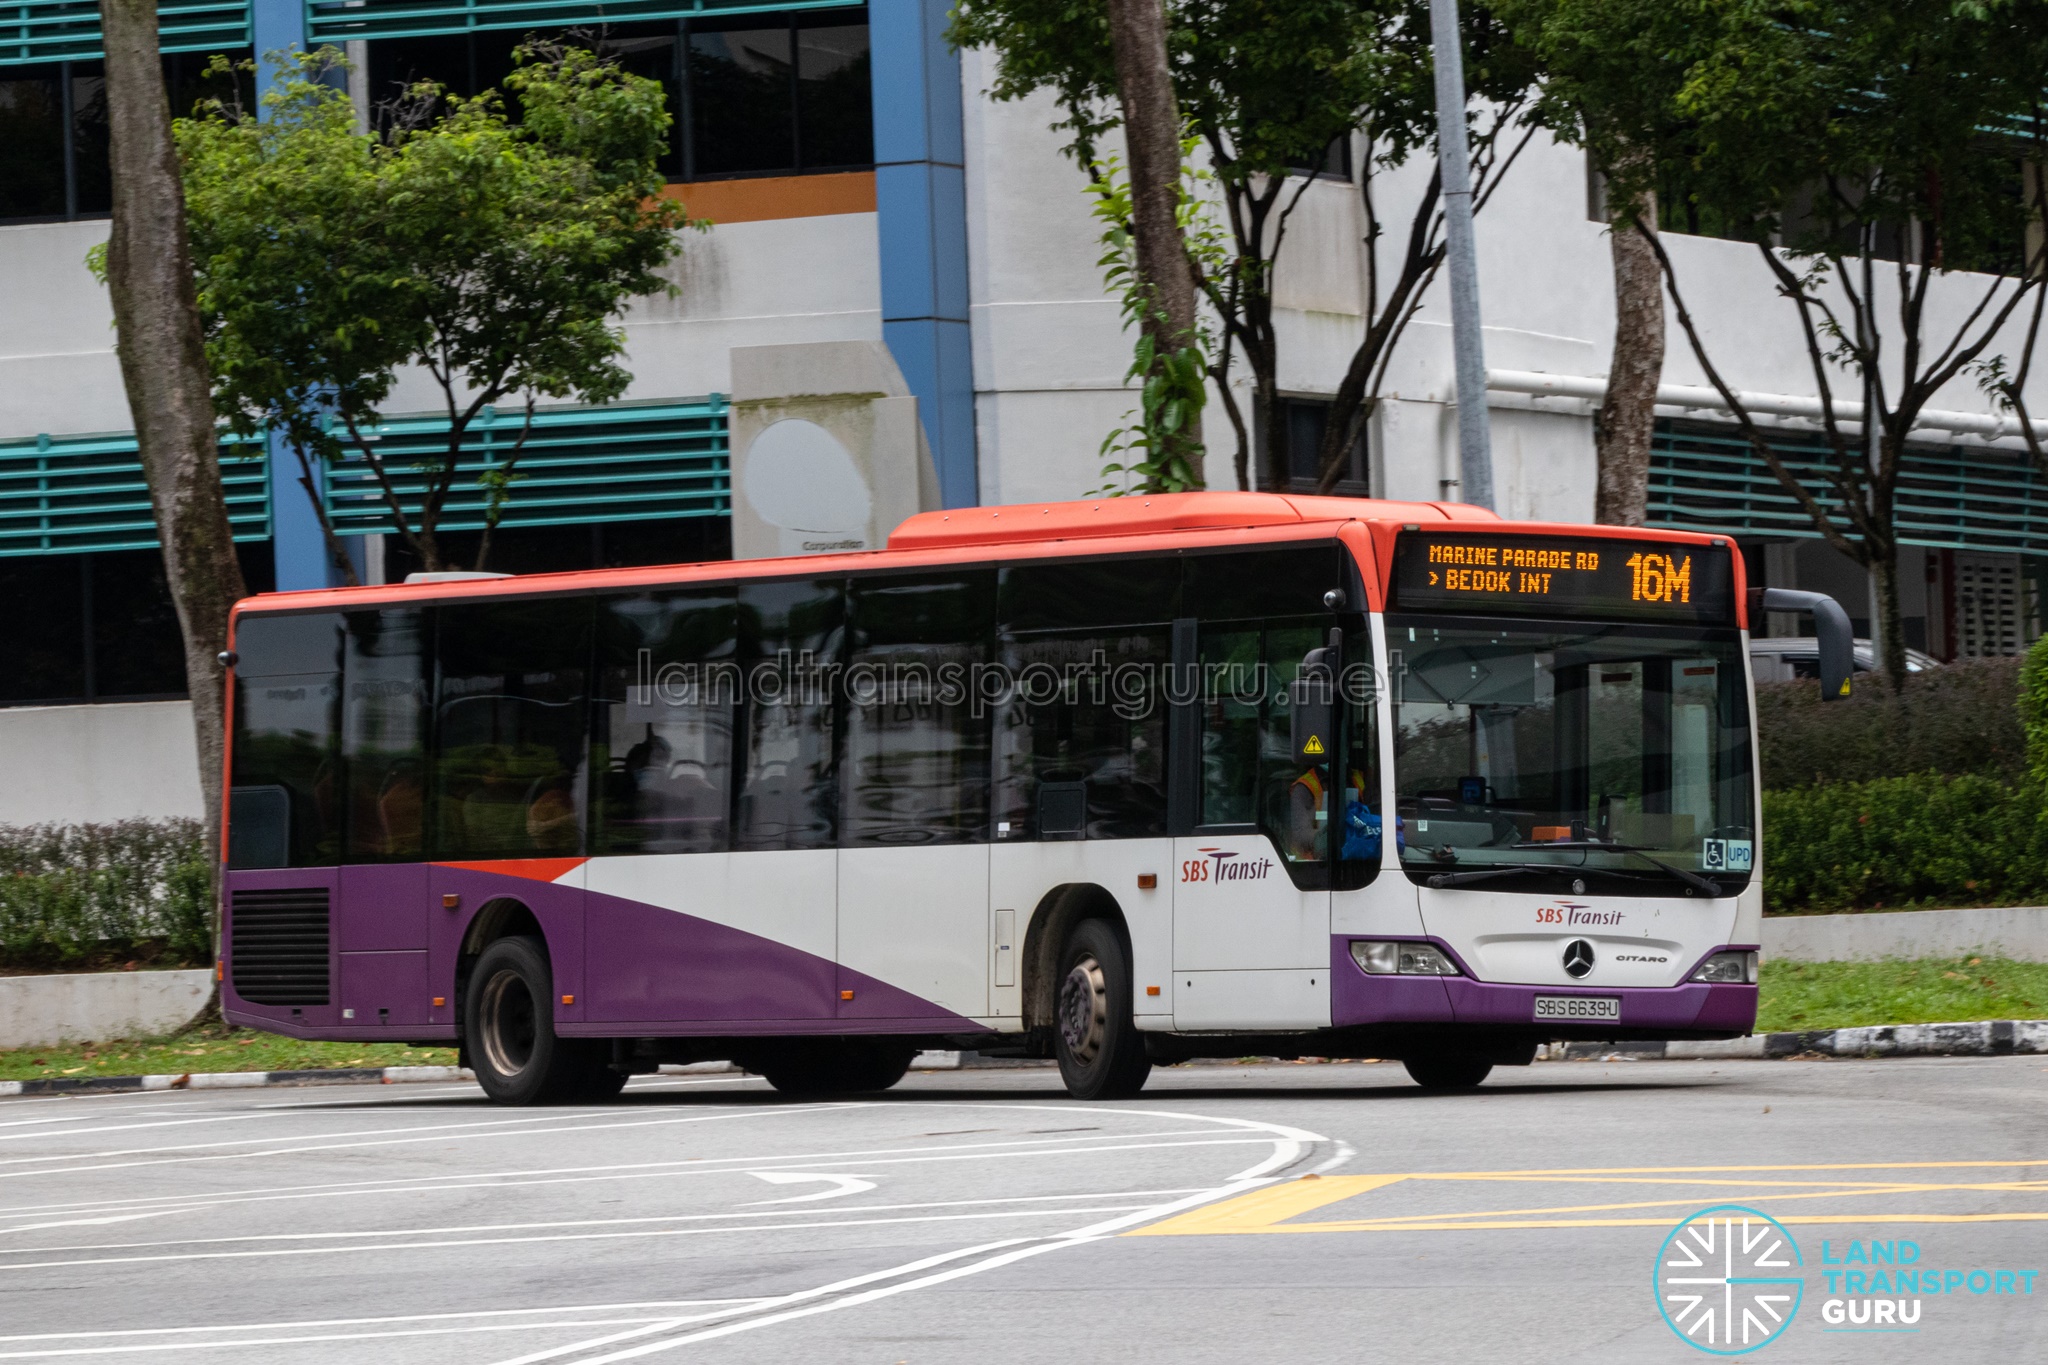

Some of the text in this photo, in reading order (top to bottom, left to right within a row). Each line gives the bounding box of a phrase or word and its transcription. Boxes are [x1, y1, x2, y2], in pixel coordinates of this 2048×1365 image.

[1429, 545, 1599, 570] MARINE PARADE RD
[1446, 569, 1552, 594] BEDOK INT
[1626, 553, 1691, 603] 16M
[1729, 847, 1751, 862] UPD
[1181, 852, 1275, 885] SBS Transit
[1535, 904, 1626, 927] SBS Transit
[1616, 955, 1668, 963] CITARO
